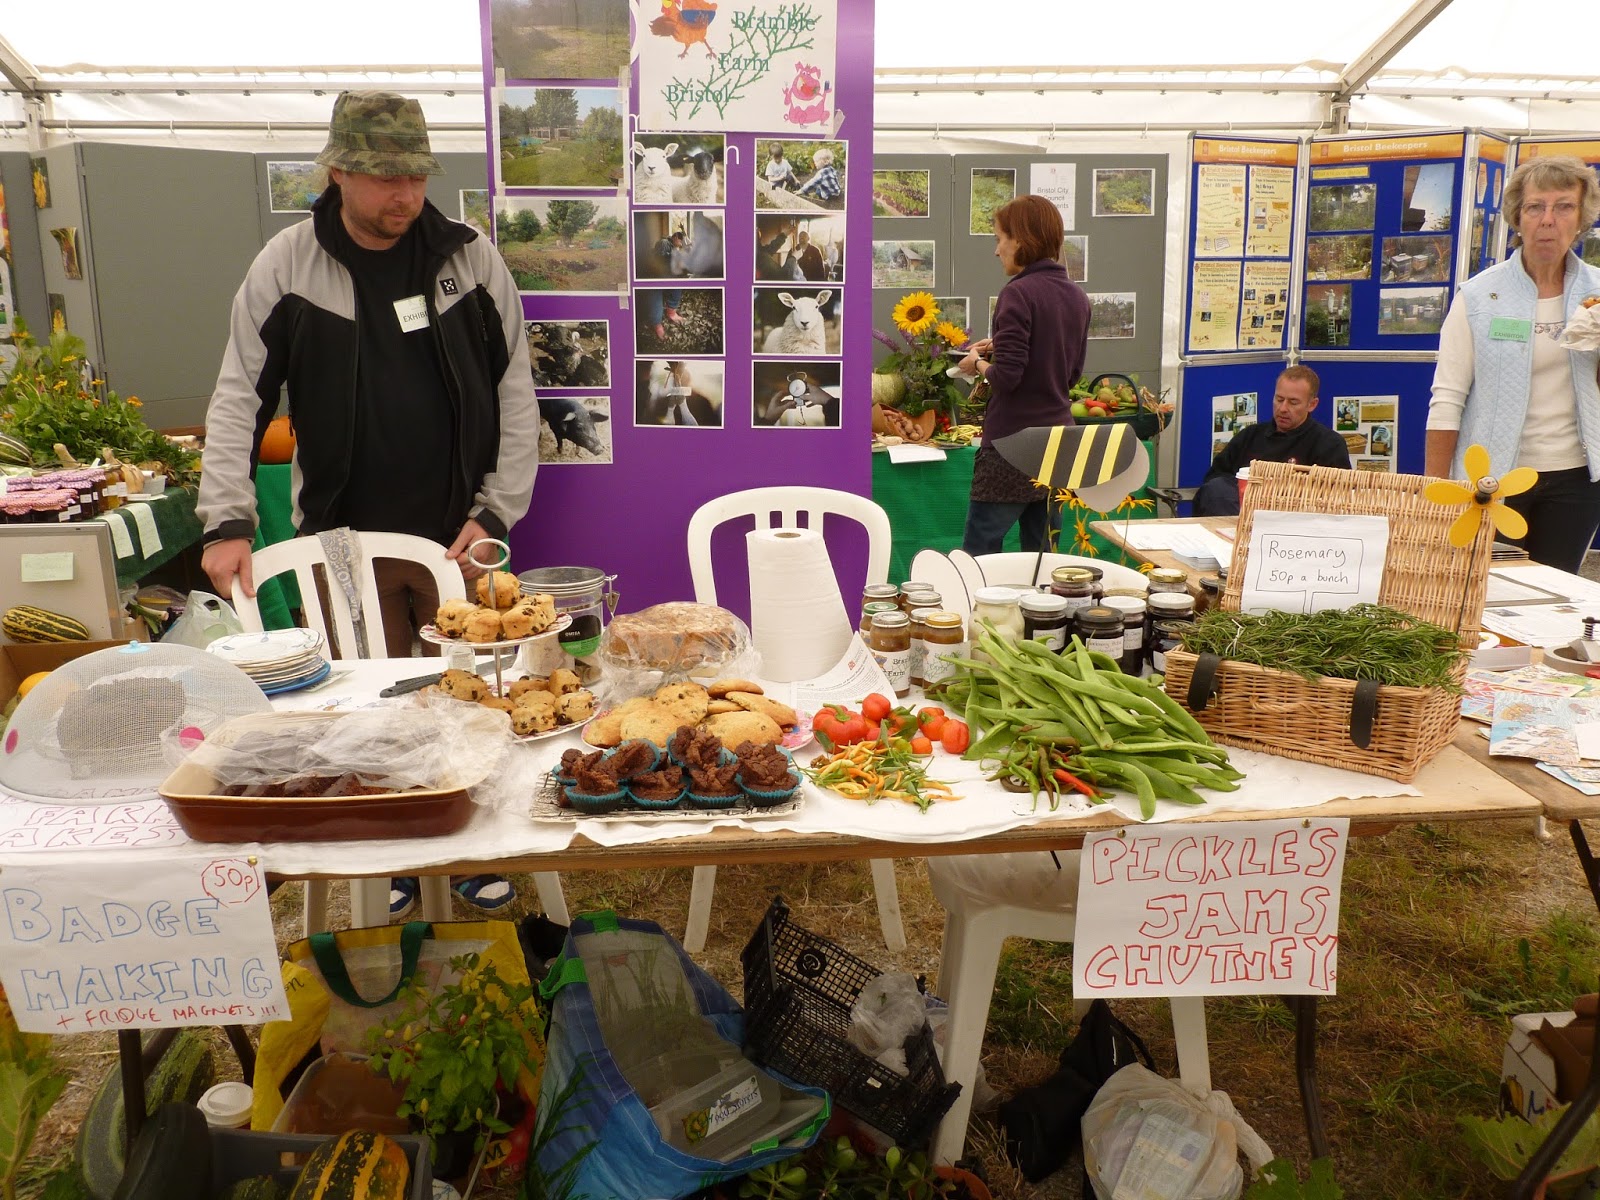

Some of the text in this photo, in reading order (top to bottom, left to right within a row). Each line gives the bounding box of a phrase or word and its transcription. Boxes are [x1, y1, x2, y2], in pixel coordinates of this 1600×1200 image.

[733, 11, 816, 32] Bramble
[719, 52, 770, 72] Farm
[666, 84, 730, 103] Bristol
[1219, 144, 1277, 156] Bristol Beekeepers
[1343, 142, 1428, 153] Bristol Beekeepers
[1269, 540, 1346, 568] Rosemary
[1269, 570, 1294, 584] 50p
[1317, 569, 1348, 584] bunch
[0, 826, 188, 848] AKES
[1093, 828, 1339, 884] PICKLES
[214, 866, 253, 893] 50p
[3, 888, 221, 943] BADGE
[1139, 886, 1330, 939] JAMS
[21, 957, 273, 1011] MAKING
[173, 1004, 255, 1020] MAGNETS
